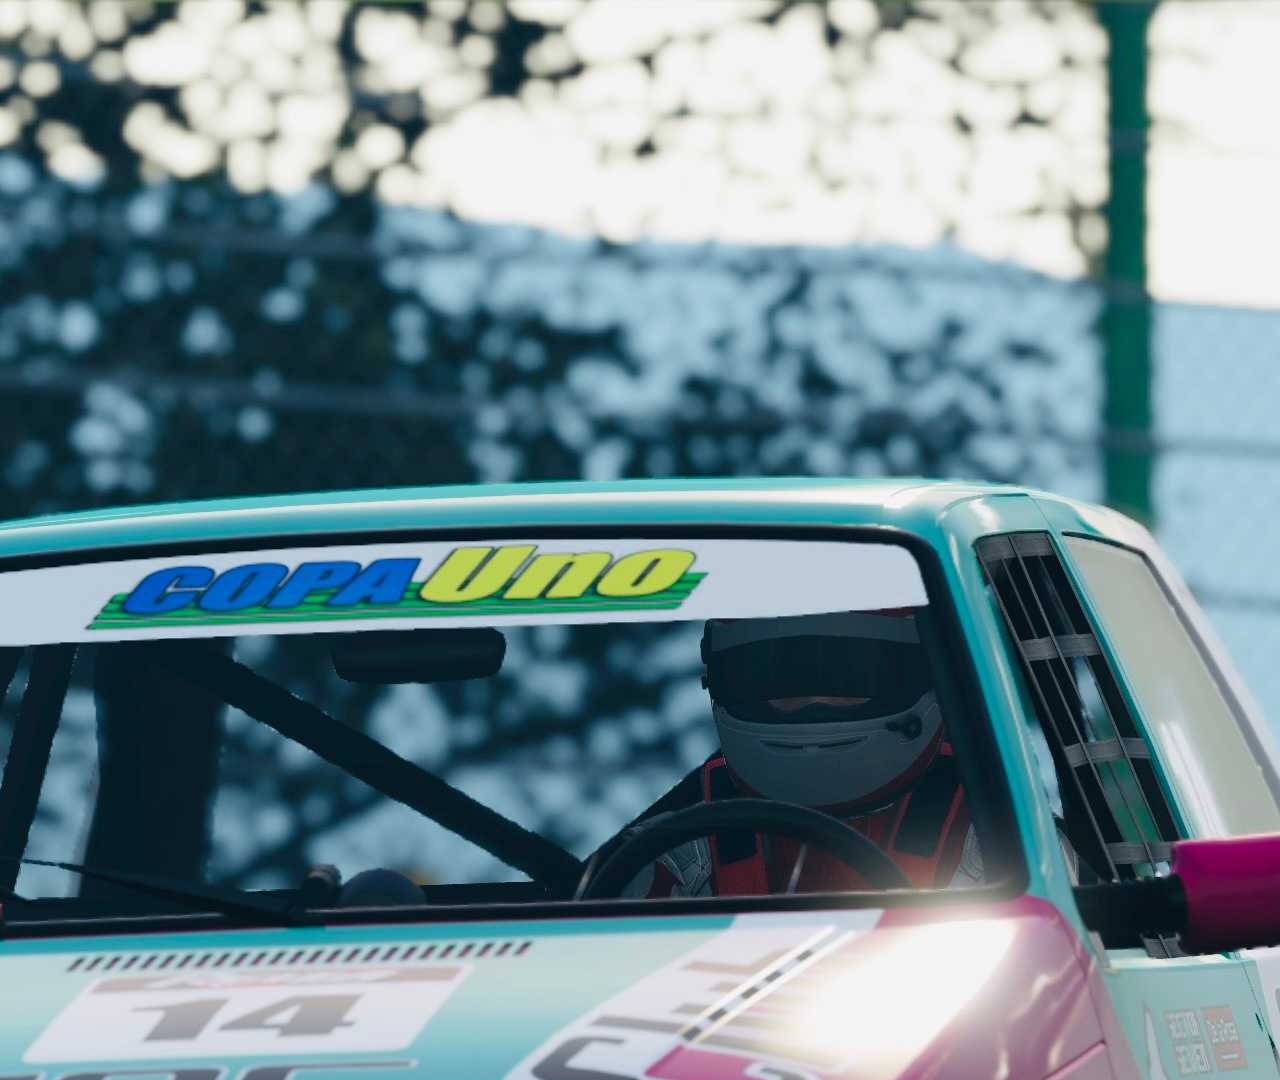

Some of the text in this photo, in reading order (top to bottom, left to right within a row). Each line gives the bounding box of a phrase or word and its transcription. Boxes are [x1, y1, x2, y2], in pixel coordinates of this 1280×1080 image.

[121, 544, 696, 615] COPA Uno
[131, 992, 365, 1043] 14
